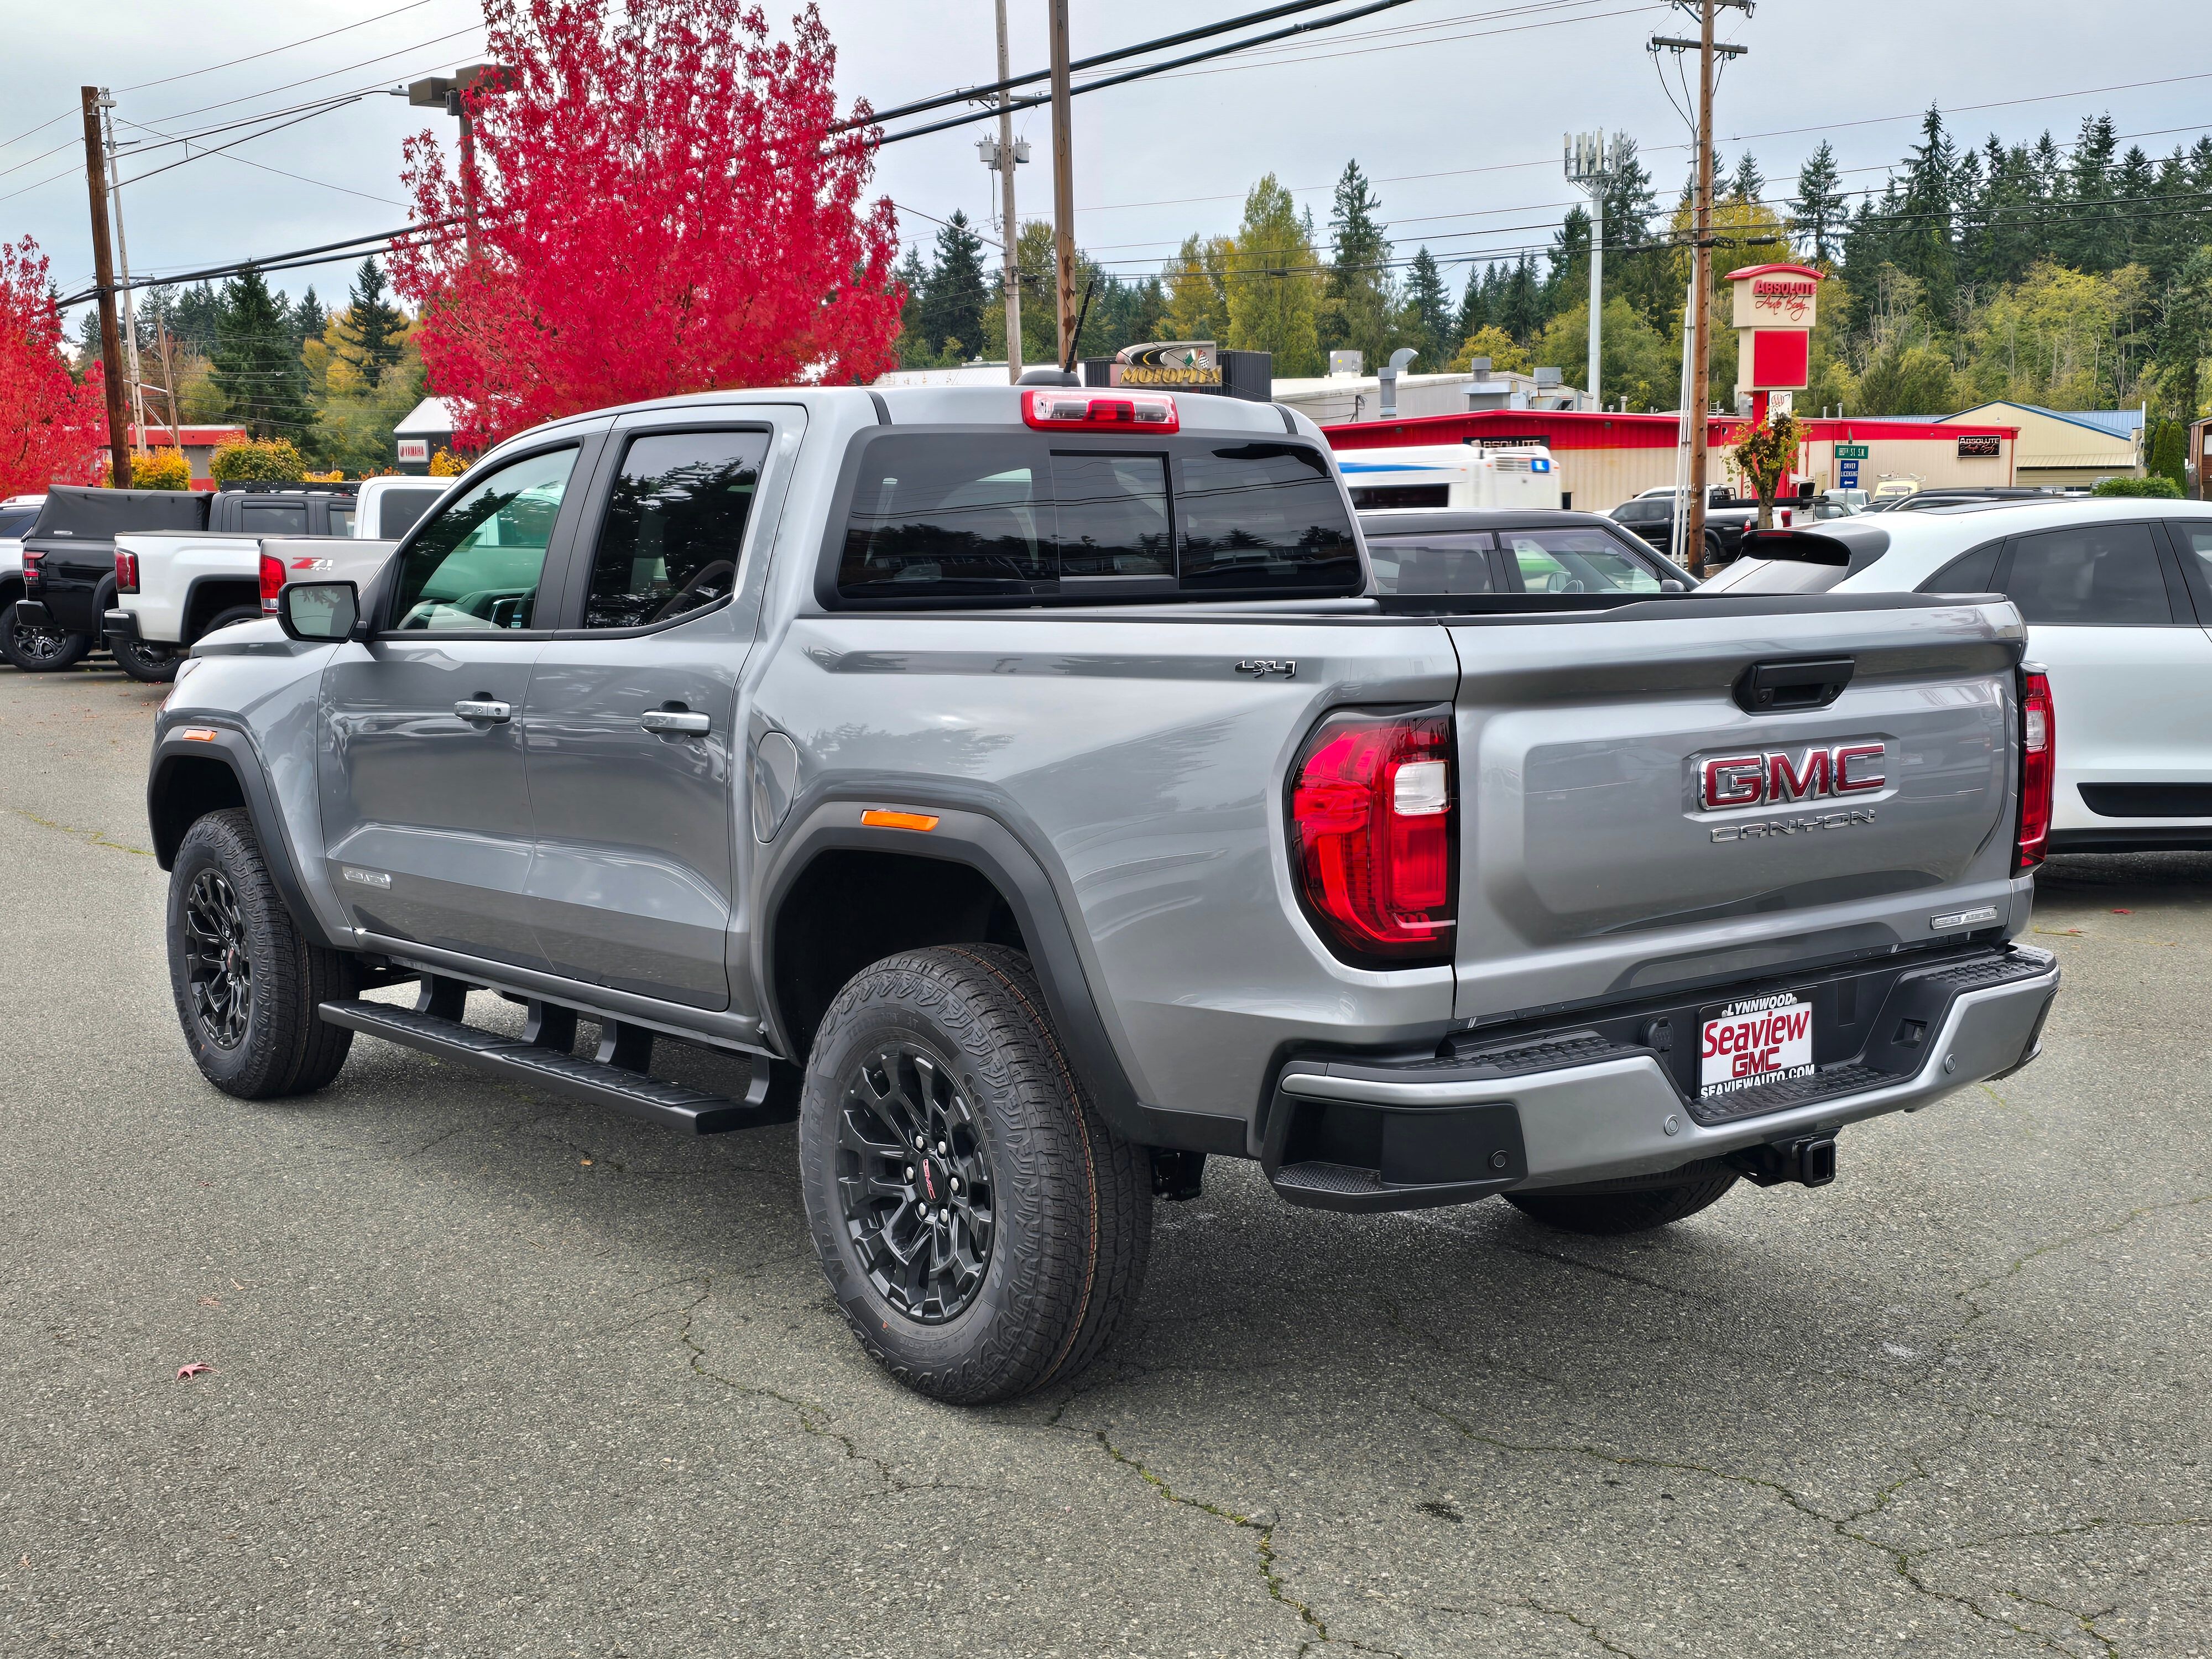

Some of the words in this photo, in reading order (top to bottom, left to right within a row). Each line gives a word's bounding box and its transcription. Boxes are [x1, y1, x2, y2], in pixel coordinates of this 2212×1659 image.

[1753, 279, 1817, 294] ABSOLUTE
[1120, 366, 1222, 384] MOTOPLEX
[290, 557, 333, 571] Z71
[1698, 743, 1885, 811] GMC
[1710, 808, 1875, 843] CANYON
[1726, 993, 1793, 1016] LYNNWOOD
[1702, 1010, 1810, 1059] Seaview
[1732, 1046, 1782, 1078] GMC
[1700, 1063, 1815, 1098] SEAVIEWAUTO.COM
